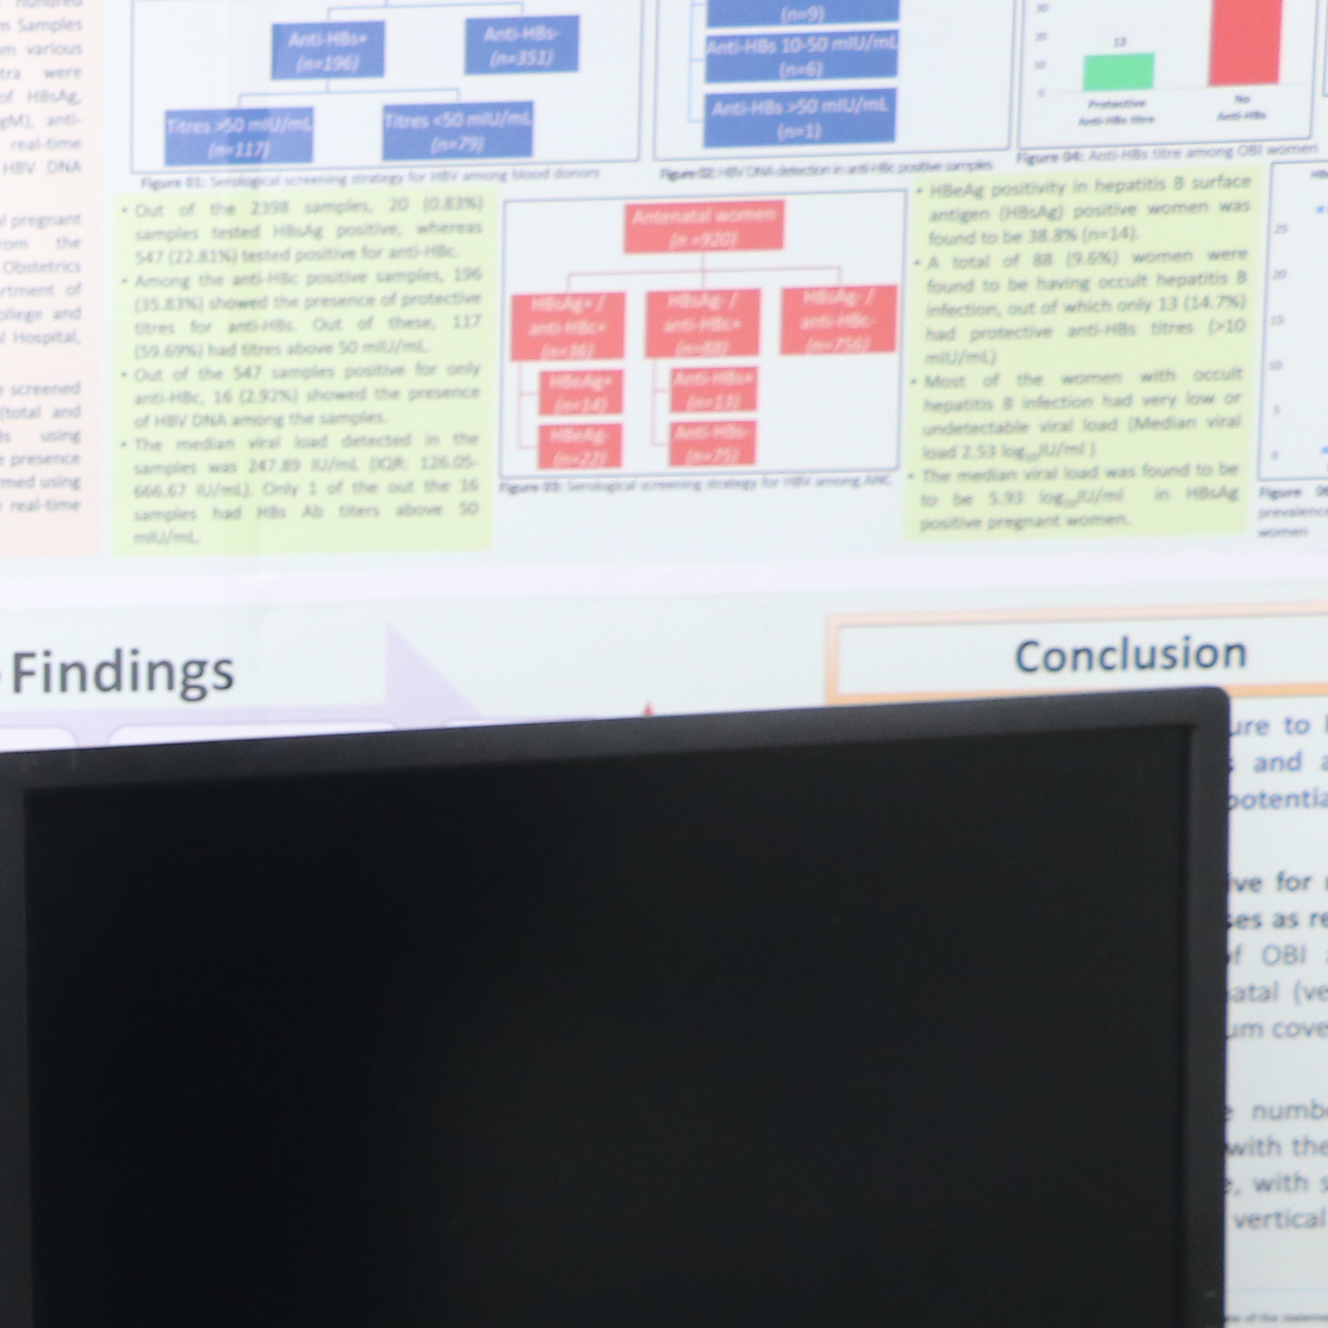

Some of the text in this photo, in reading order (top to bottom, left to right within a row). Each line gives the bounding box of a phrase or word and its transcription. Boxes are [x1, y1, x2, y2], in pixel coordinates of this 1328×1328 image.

[928, 174, 1251, 200] HBeAg positivity in hepatitis B surface
[927, 201, 1250, 225] antigen (HBsAg) positive women was
[926, 227, 1140, 247] found to be 38.8% (n=14).
[1014, 636, 1247, 673] Conclusion
[12, 648, 234, 701] Findings
[1285, 716, 1311, 735] to
[1253, 751, 1302, 772] and
[1276, 870, 1312, 892] for
[1272, 912, 1299, 929] as
[1261, 944, 1307, 966] OBI
[1252, 1172, 1309, 1193] with
[1233, 1206, 1325, 1230] vertical
